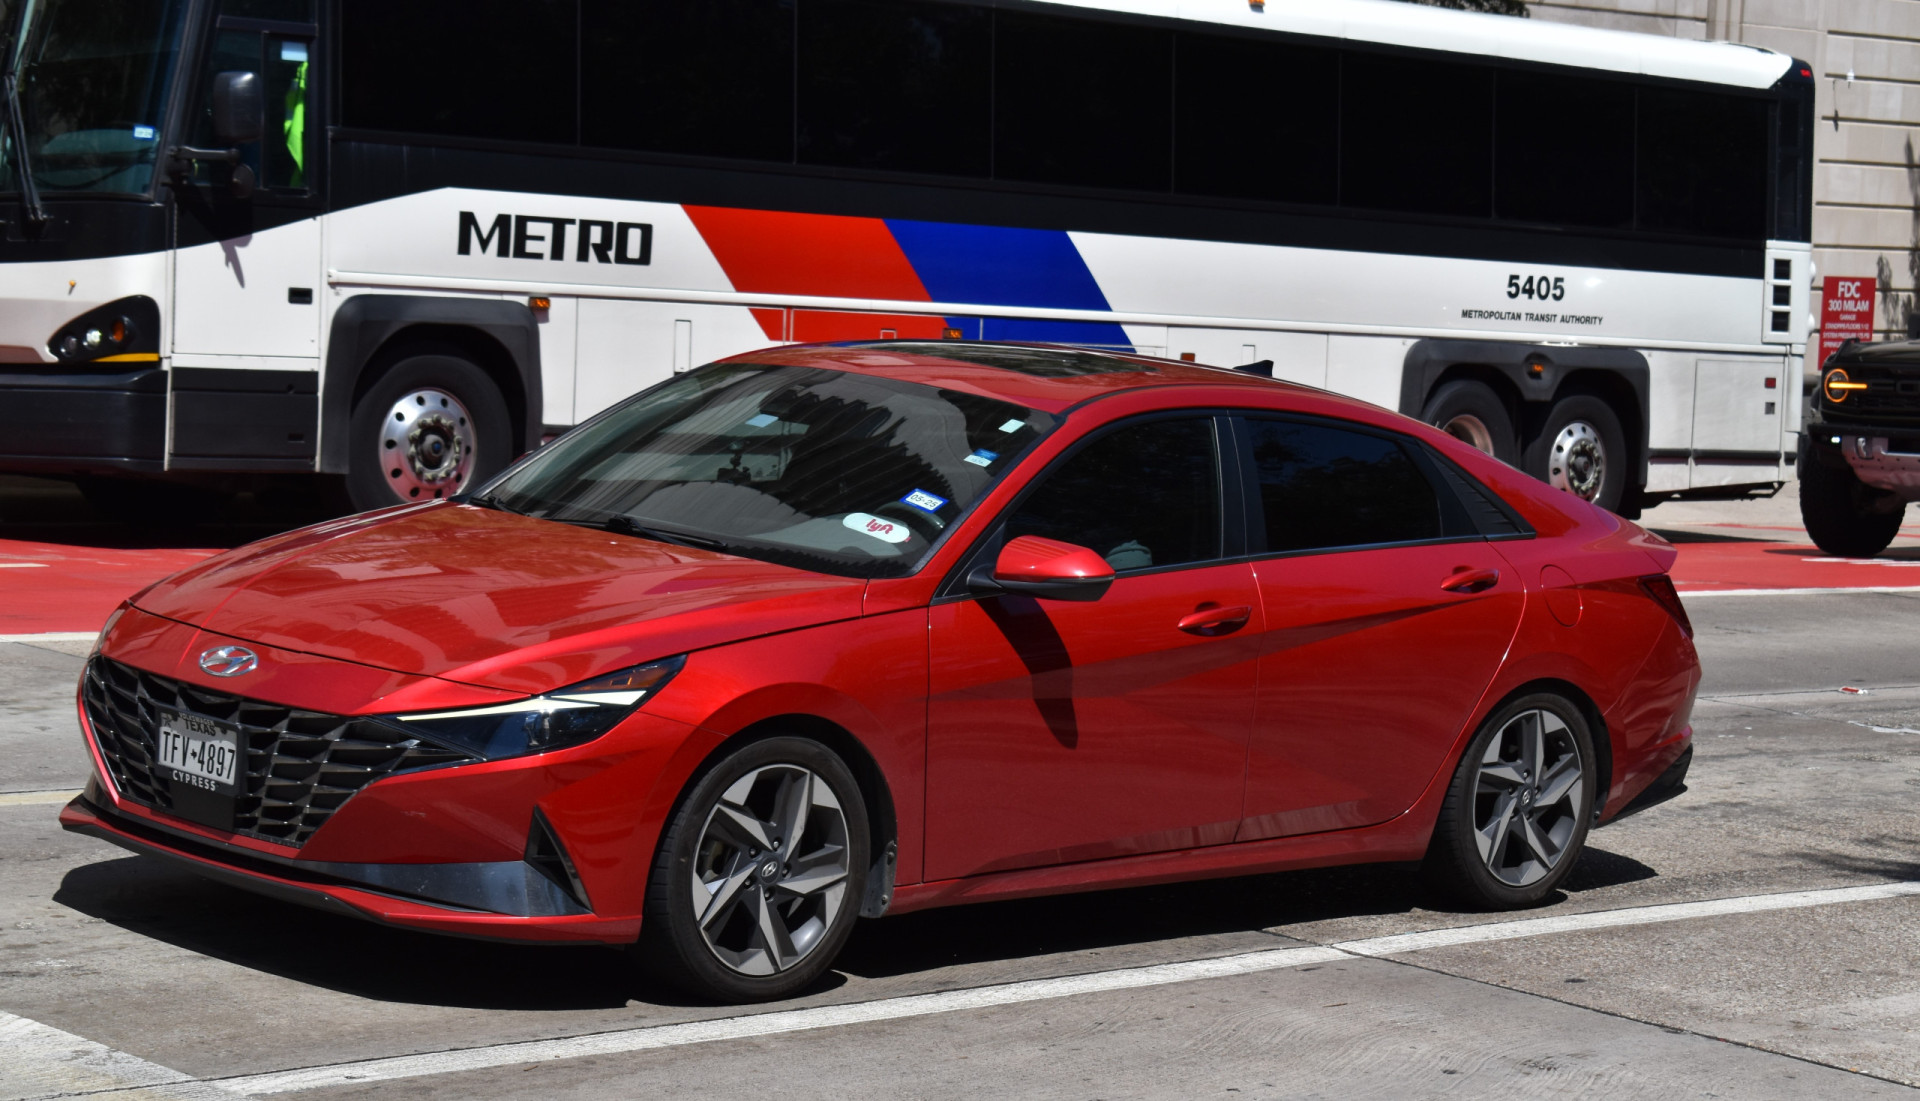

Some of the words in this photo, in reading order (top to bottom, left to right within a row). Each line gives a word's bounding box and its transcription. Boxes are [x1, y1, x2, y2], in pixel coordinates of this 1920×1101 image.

[457, 210, 653, 266] METRO
[1506, 274, 1565, 301] 5405
[1837, 281, 1861, 298] FDC
[1828, 299, 1843, 312] 300
[1843, 299, 1869, 312] MILAM
[1461, 309, 1521, 321] METROPOLITAN
[1525, 312, 1557, 323] TRANSIT
[1559, 314, 1603, 326] AUTHORITY
[866, 518, 894, 534] lyft
[184, 718, 216, 737] TEXAS
[172, 769, 216, 791] CYPRESS
